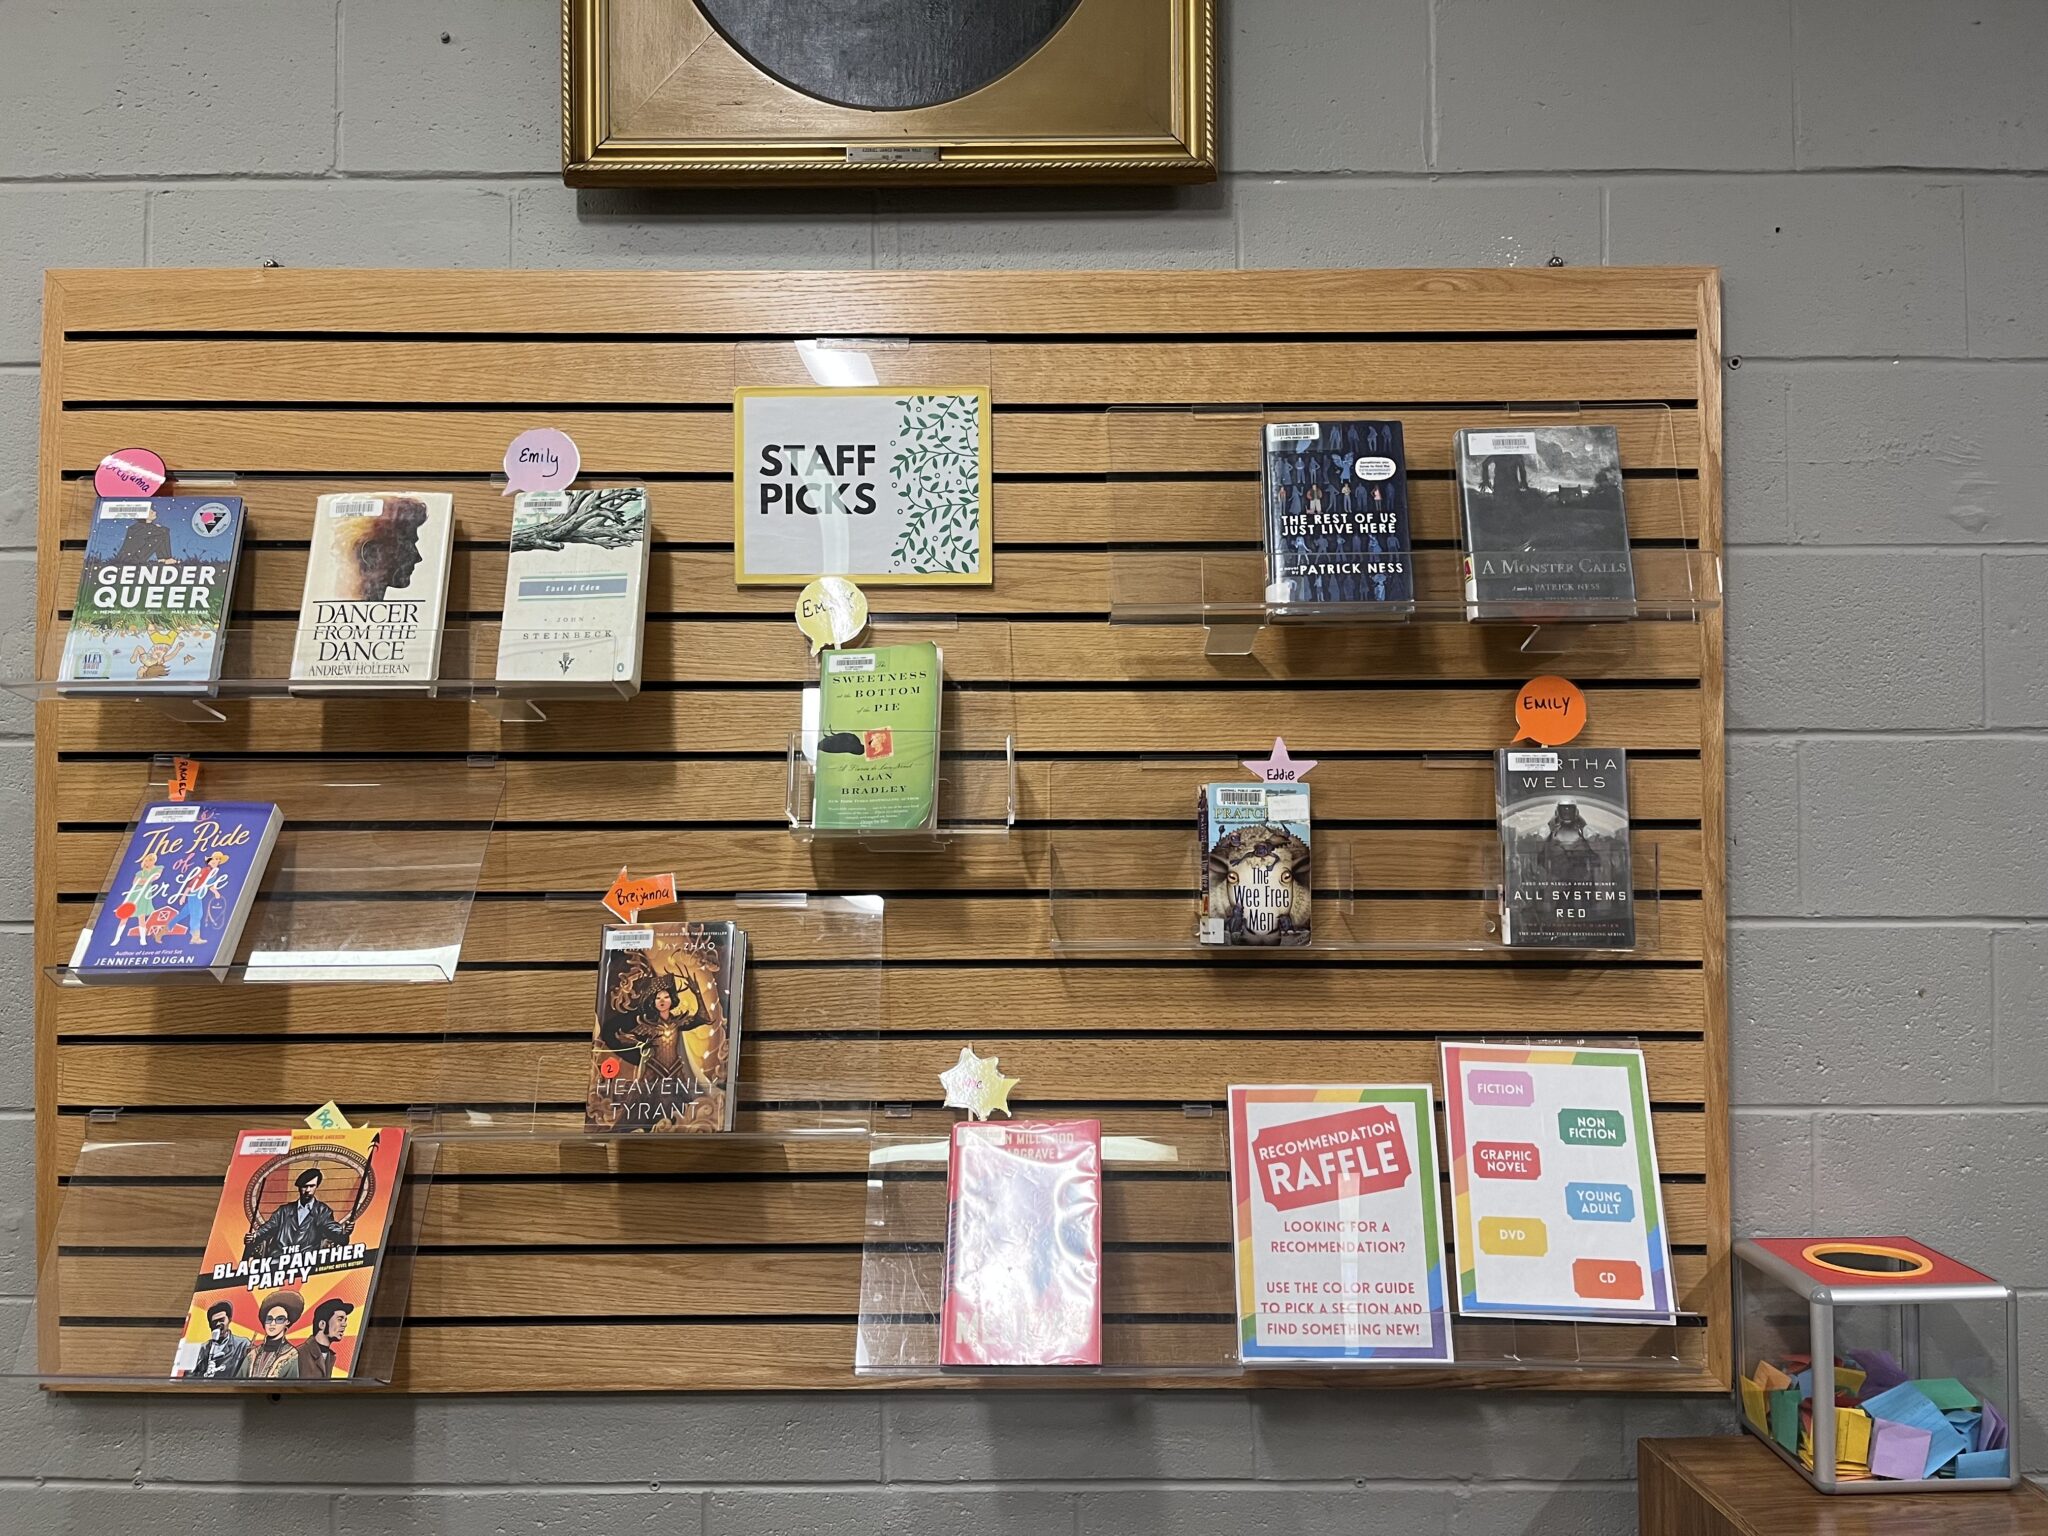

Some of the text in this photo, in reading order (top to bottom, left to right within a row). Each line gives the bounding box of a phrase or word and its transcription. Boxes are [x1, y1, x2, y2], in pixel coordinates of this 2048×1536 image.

[519, 448, 559, 477] Emily
[759, 444, 876, 477] STAFF
[760, 482, 877, 515] PICKS
[1281, 513, 1397, 526] THE REST OF US
[1282, 522, 1396, 536] JUST LIVE HERE
[1300, 563, 1403, 575] PATRICK NESS
[1482, 560, 1495, 575] A
[98, 565, 216, 585] GENDER
[1577, 583, 1600, 591] NESS
[93, 586, 210, 608] QUEER
[317, 604, 418, 624] DANCER
[313, 625, 418, 640] FROM THE
[523, 630, 613, 640] STEINBECK
[318, 641, 405, 662] DANCE
[308, 664, 410, 677] ANDREW HOLLERAN
[832, 670, 927, 685] SWEETNESS
[855, 686, 920, 698] BOTTOM
[874, 703, 900, 712] PIE
[1524, 696, 1570, 715] EMILY
[857, 773, 892, 782] ALAN
[1266, 769, 1295, 781] Eddie
[1522, 777, 1606, 788] WELLS
[841, 785, 907, 795] BRADLEY
[135, 821, 250, 863] The Ride
[172, 852, 195, 873] of
[1252, 867, 1269, 885] The
[121, 866, 228, 905] Her Life
[1233, 885, 1290, 908] Wee Free
[1514, 890, 1627, 901] ALL SYSTEMS
[1556, 908, 1586, 918] RED
[1249, 911, 1275, 932] Men
[658, 943, 677, 951] JAY
[683, 942, 716, 951] ZHAO
[94, 956, 195, 966] JENNIFER DUGAN
[606, 1064, 614, 1074] 2
[596, 1076, 719, 1096] HEAVENLY
[1477, 1083, 1524, 1095] FICTION
[609, 1100, 698, 1120] TYRANT
[1577, 1117, 1605, 1127] NON
[1259, 1120, 1397, 1160] RECOMMENDATION
[1568, 1127, 1617, 1140] FICTION
[1480, 1149, 1532, 1161] GRAPHIC
[1267, 1140, 1400, 1195] RAFFLE
[1487, 1161, 1527, 1173] NOVEL
[1576, 1190, 1622, 1203] YOUNG
[1581, 1203, 1620, 1214] ADULT
[1284, 1221, 1390, 1233] LOOKING FOR A
[1499, 1229, 1526, 1241] DVD
[282, 1245, 300, 1254] THE
[1271, 1241, 1406, 1253] RECOMMENDATION?
[213, 1243, 366, 1280] BLACK PANTHER
[247, 1266, 312, 1290] PARTY
[1599, 1272, 1617, 1283] CD
[1266, 1282, 1416, 1293] USE THE COLOR GUIDE
[1261, 1302, 1423, 1314] TO PICK A SECTION AND
[1267, 1323, 1420, 1335] FIND SOMETHING NEW!
